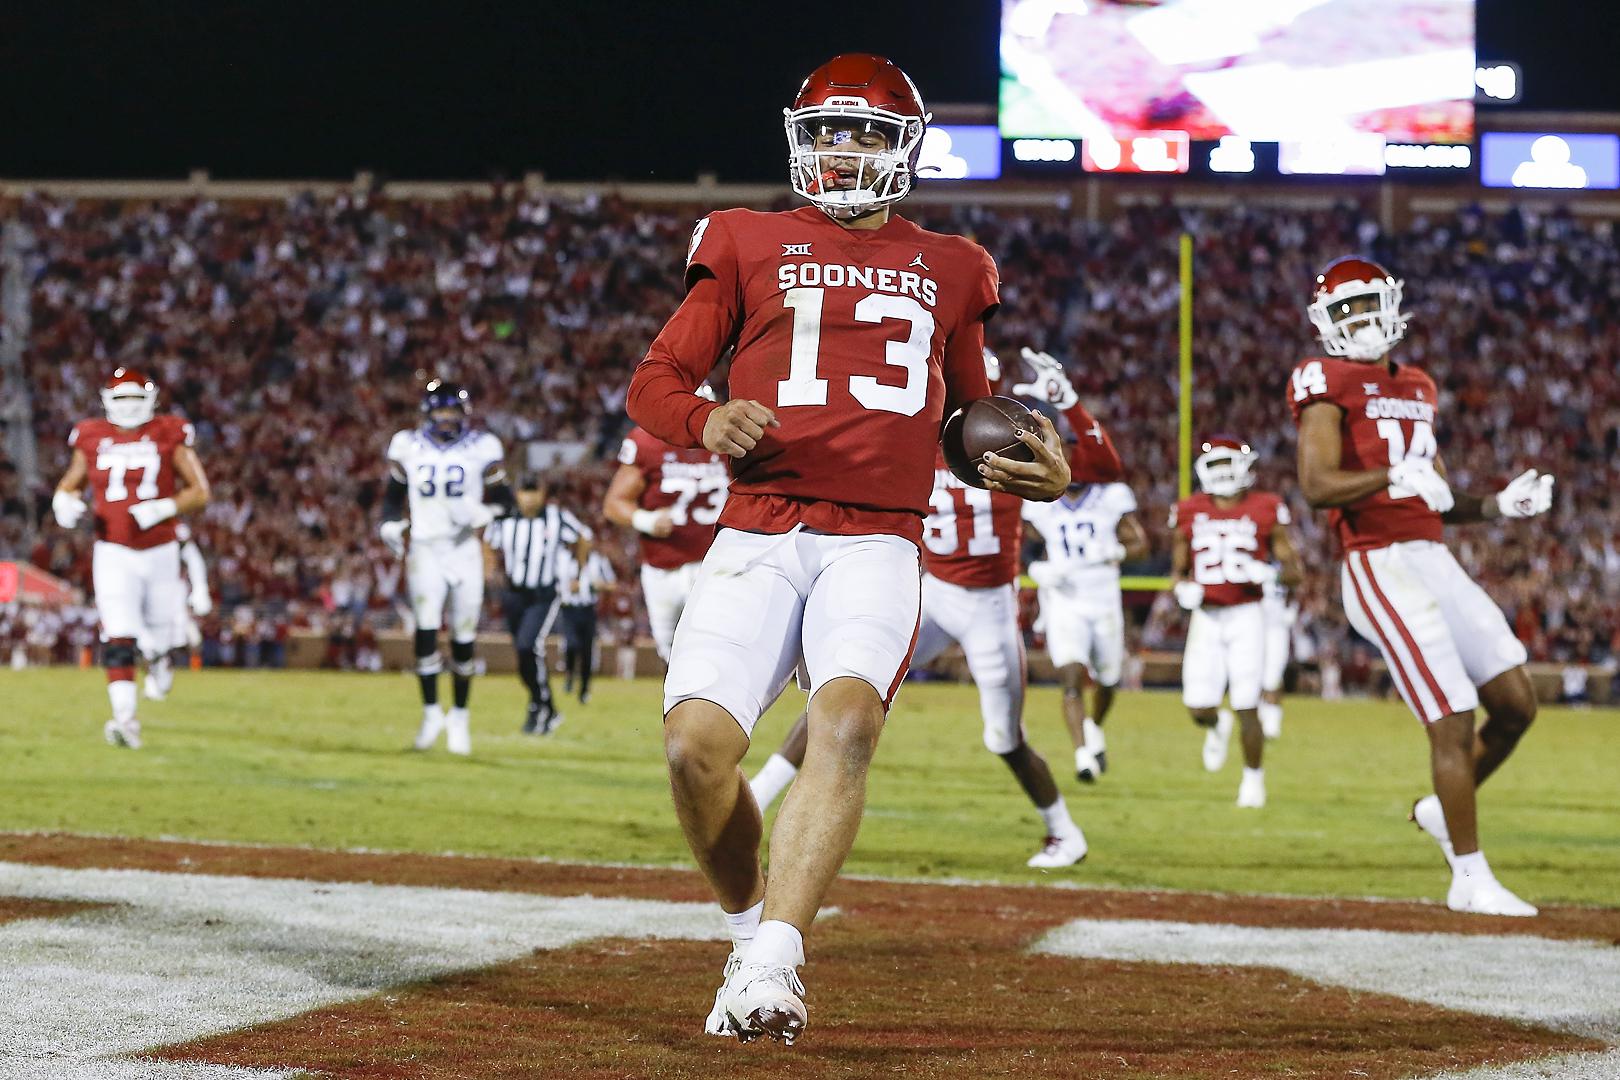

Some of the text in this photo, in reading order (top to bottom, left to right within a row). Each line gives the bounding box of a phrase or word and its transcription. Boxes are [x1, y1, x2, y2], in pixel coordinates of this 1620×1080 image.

[778, 262, 938, 307] SOONERS
[777, 287, 935, 417] 13
[1292, 361, 1328, 402] 14
[96, 452, 161, 502] 77
[417, 464, 465, 497] 32
[1376, 418, 1438, 499] 14
[660, 476, 730, 526] 73
[1191, 536, 1258, 585] 26
